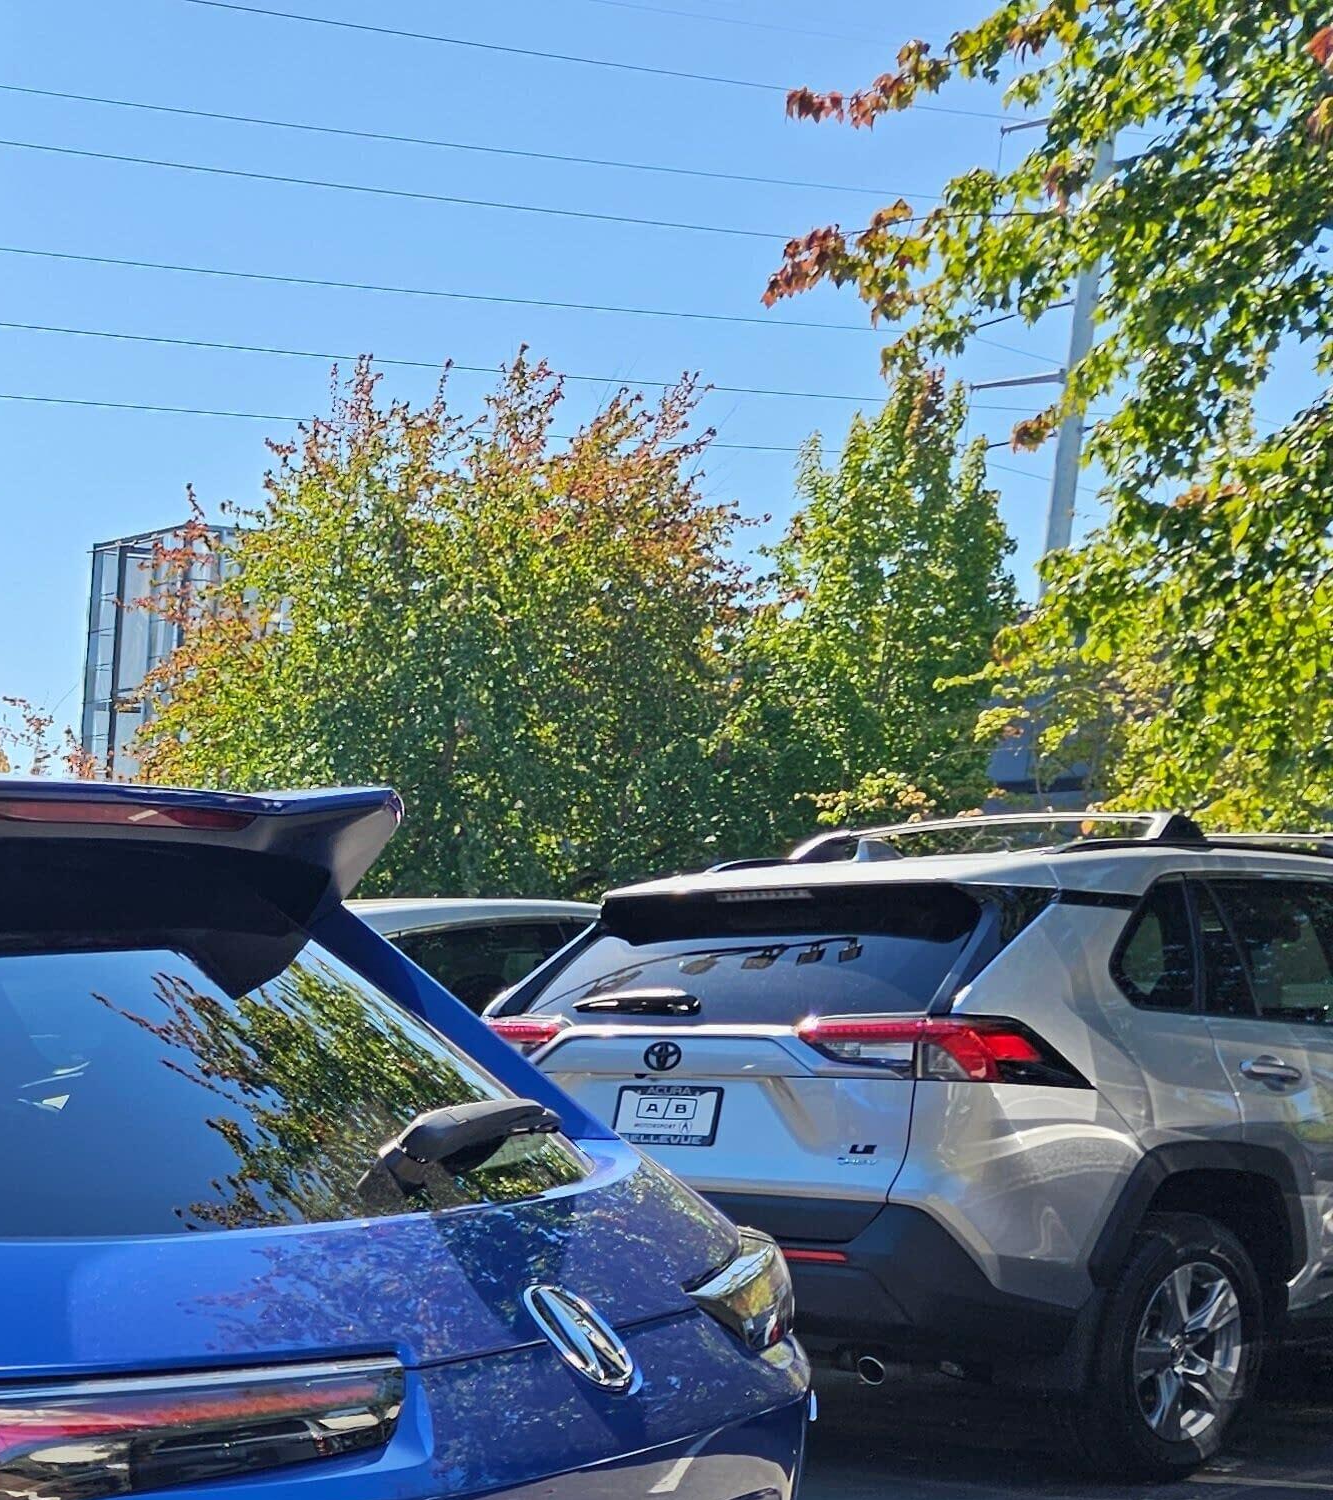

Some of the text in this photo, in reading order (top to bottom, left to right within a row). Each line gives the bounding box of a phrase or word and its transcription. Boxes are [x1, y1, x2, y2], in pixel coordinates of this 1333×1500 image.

[646, 1086, 693, 1095] ACURA
[645, 1103, 687, 1114] A B
